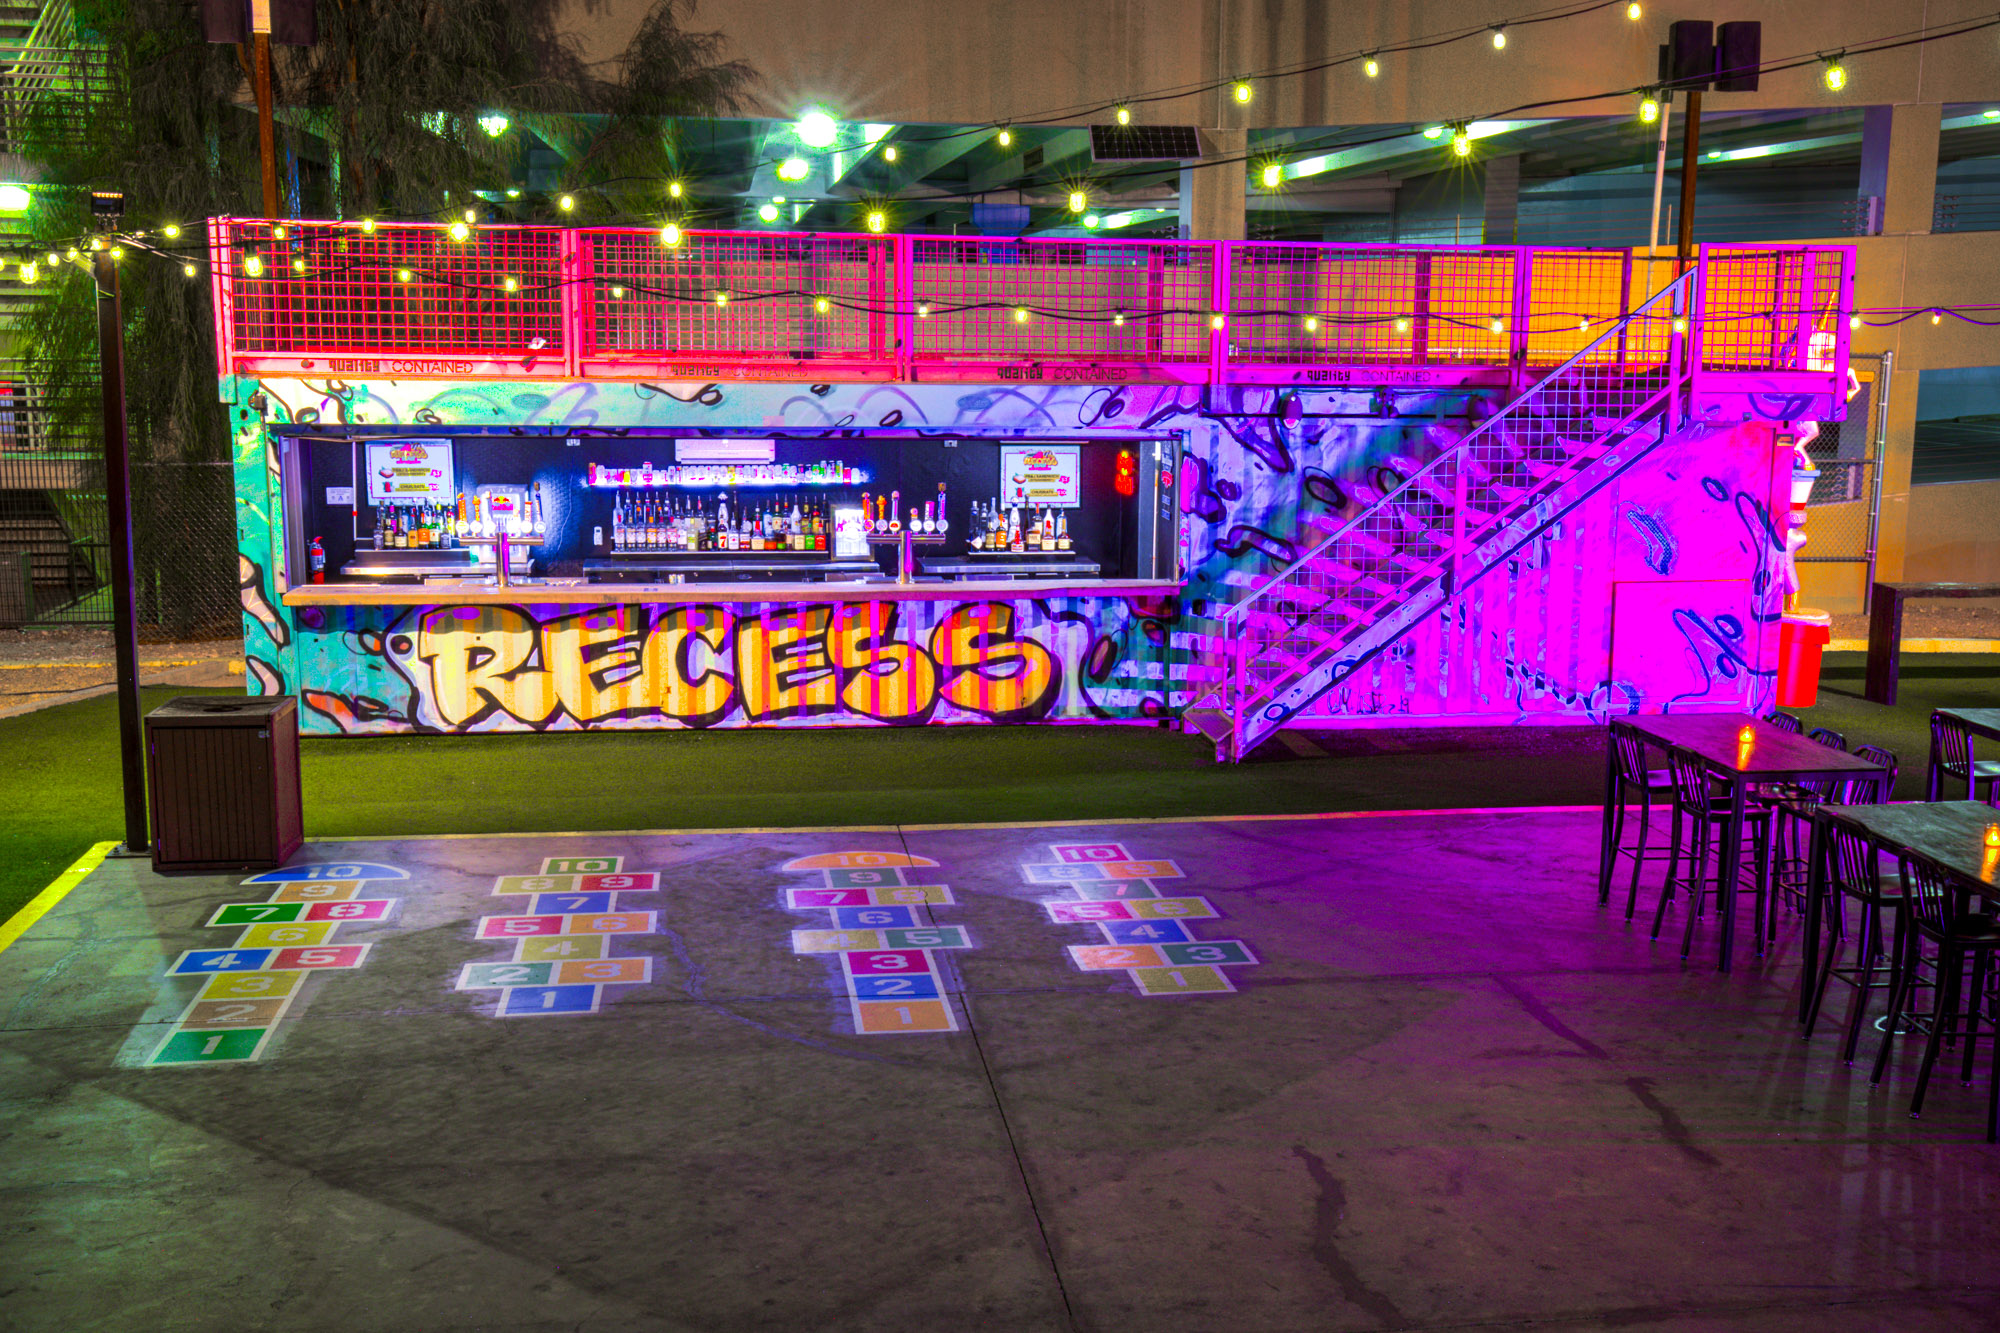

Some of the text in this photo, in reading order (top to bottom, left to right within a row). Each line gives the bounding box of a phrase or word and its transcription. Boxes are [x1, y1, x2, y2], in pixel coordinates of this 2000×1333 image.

[391, 360, 474, 374] CONTAINED
[731, 365, 808, 377] CONTAINED
[1053, 368, 1128, 381] CONTAINED
[1361, 371, 1431, 382] CONTAINED
[719, 536, 727, 548] 7
[417, 600, 1064, 726] RECESS
[837, 855, 888, 865] 10
[1065, 848, 1118, 860] 10
[307, 866, 362, 878] 10
[557, 860, 609, 872] 10
[1048, 867, 1083, 878] 8
[1124, 864, 1158, 875] 9
[520, 878, 555, 890] 8
[600, 876, 634, 888] 9
[849, 872, 882, 883] 9
[299, 885, 336, 897] 9
[892, 889, 927, 902] 8
[1097, 884, 1128, 895] 7
[557, 897, 590, 910] 7
[816, 892, 848, 904] 7
[245, 907, 279, 920] 7
[328, 903, 366, 917] 8
[1071, 904, 1110, 918] 5
[1152, 902, 1189, 915] 6
[592, 917, 627, 930] 6
[858, 911, 894, 924] 6
[504, 919, 541, 933] 5
[1130, 925, 1164, 939] 4
[268, 928, 309, 941] 6
[823, 934, 858, 947] 4
[904, 931, 942, 944] 5
[542, 941, 579, 955] 4
[1185, 946, 1227, 961] 3
[202, 953, 241, 969] 4
[297, 949, 341, 965] 5
[870, 955, 909, 970] 3
[1098, 949, 1139, 964] 2
[489, 967, 531, 983] 2
[583, 963, 621, 978] 3
[230, 977, 274, 992] 3
[1168, 971, 1188, 986] 1
[874, 979, 915, 995] 2
[541, 991, 557, 1008] 1
[207, 1004, 256, 1024] 2
[895, 1007, 913, 1024] 1
[200, 1035, 224, 1055] 1
